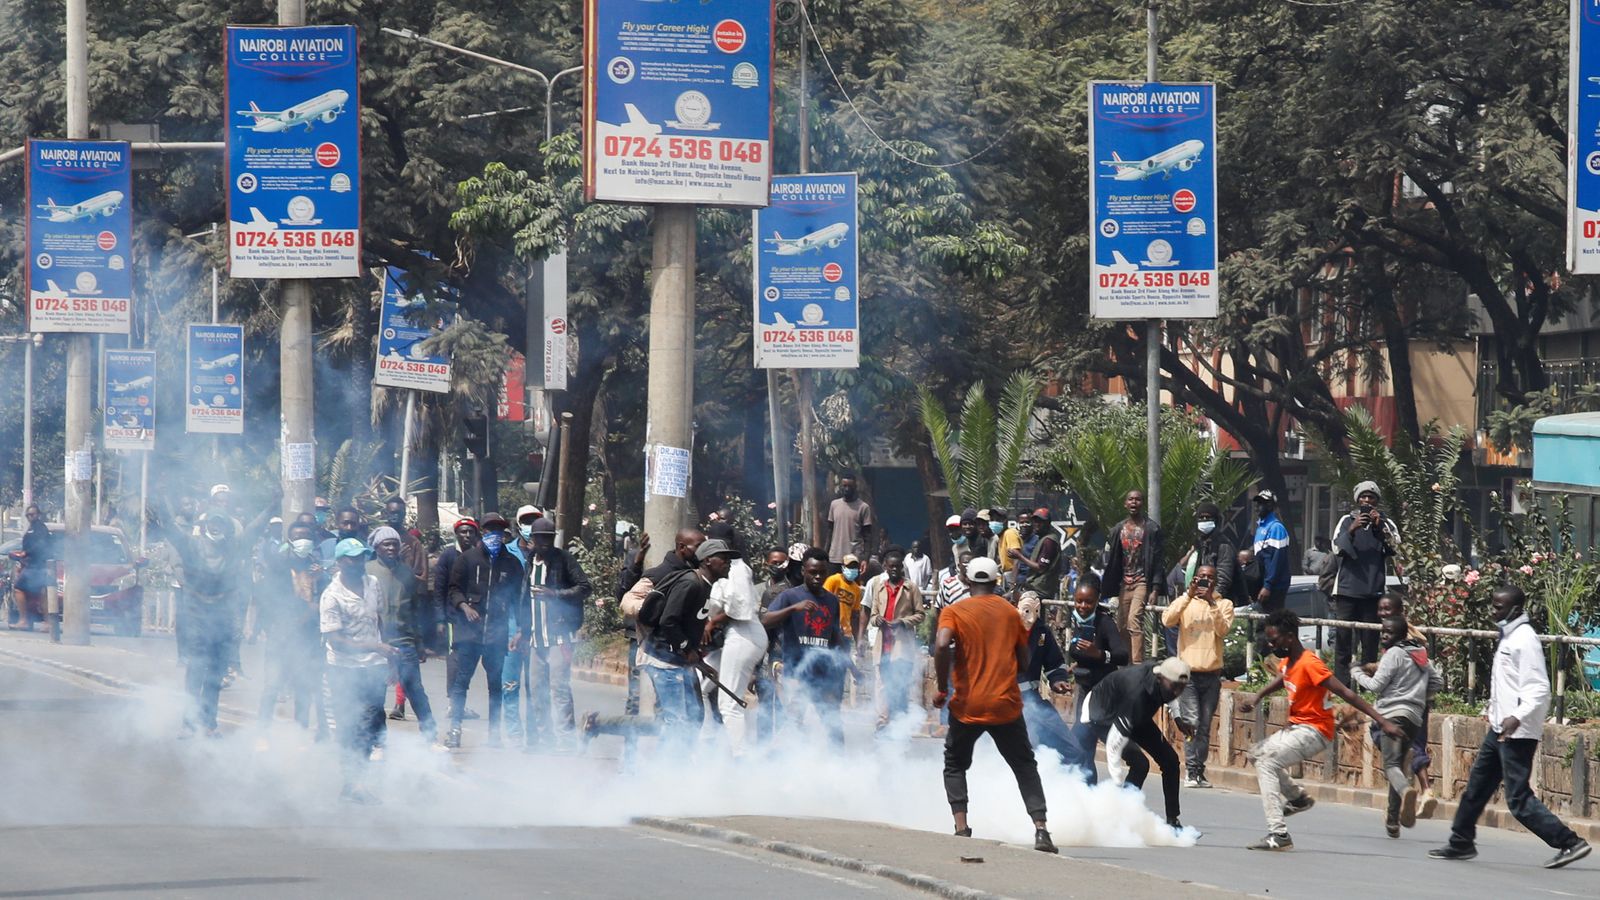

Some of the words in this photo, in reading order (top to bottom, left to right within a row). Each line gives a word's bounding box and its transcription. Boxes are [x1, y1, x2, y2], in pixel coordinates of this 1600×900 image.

[622, 22, 636, 31] Fly
[657, 23, 685, 32] Career
[686, 25, 710, 34] High!
[240, 40, 287, 52] NAIROBI
[290, 38, 343, 52] AVIATION
[1104, 92, 1147, 106] NAIROBI
[1150, 92, 1200, 104] AVIATION
[1122, 106, 1183, 114] COLLEGE
[40, 150, 78, 160] NAIROBI
[80, 150, 120, 162] AVIATION
[604, 136, 662, 158] 0724
[670, 138, 712, 160] 536
[719, 140, 762, 163] 048
[56, 160, 108, 168] COLLEGE
[805, 184, 846, 194] AVIATION
[236, 232, 278, 247] 0724
[284, 232, 316, 247] 536
[322, 232, 354, 247] 048
[1100, 273, 1139, 288] 0724
[1144, 272, 1174, 287] 536
[1179, 272, 1210, 286] 048
[36, 298, 68, 310] 0724
[73, 300, 98, 311] 536
[102, 300, 126, 312] 048
[764, 330, 796, 342] 0724
[800, 330, 824, 342] 536
[828, 330, 853, 342] 048
[380, 360, 404, 370] 0724
[407, 362, 424, 372] 536
[428, 364, 446, 374] 048
